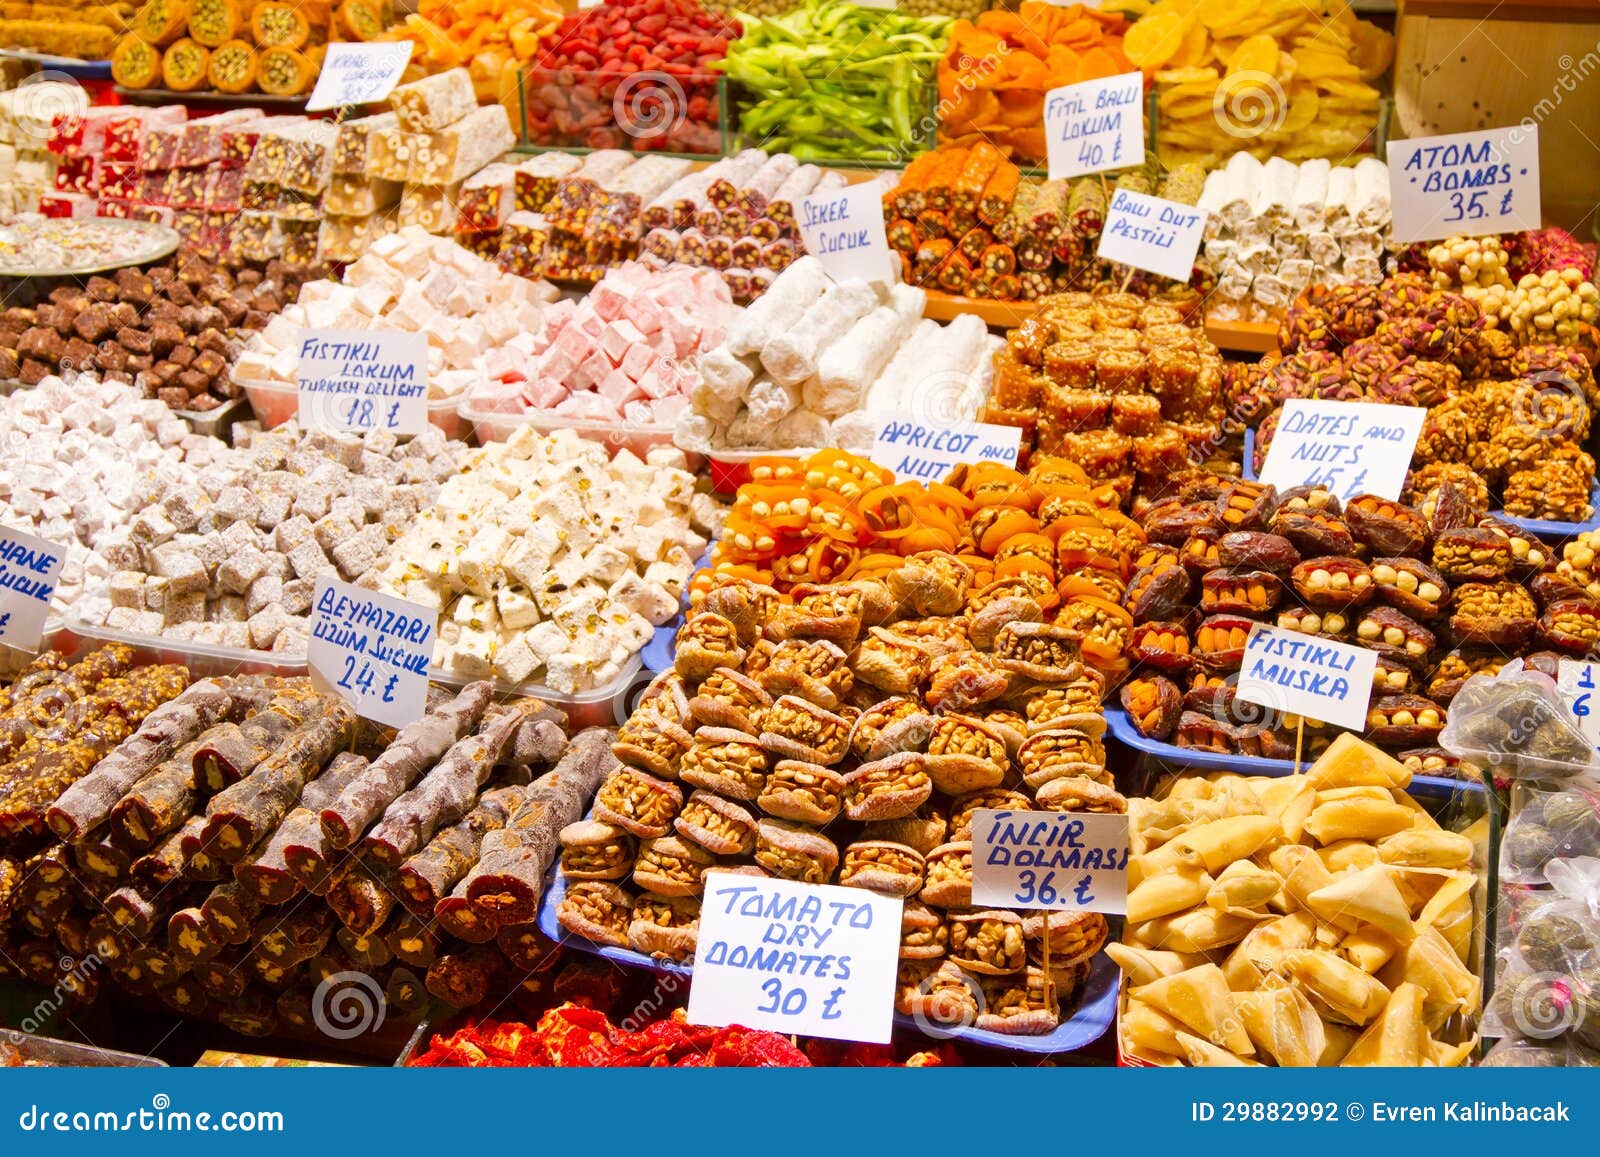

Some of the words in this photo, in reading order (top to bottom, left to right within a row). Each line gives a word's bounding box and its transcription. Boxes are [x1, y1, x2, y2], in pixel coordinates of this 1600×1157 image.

[1096, 86, 1138, 109] BALLI
[1062, 111, 1121, 141] LOKUM
[1404, 140, 1491, 171] ATOM
[1112, 192, 1151, 217] BALLI
[1160, 207, 1200, 228] DUT
[819, 229, 871, 254] SUCUK
[300, 338, 380, 360] FISTIKLI
[340, 362, 415, 381] LOKUM
[298, 379, 359, 395] TURKISH
[365, 382, 425, 397] DELIGHT
[879, 421, 978, 454] APRICOT
[978, 445, 1016, 461] AND
[1282, 410, 1360, 436] DATES
[1363, 426, 1405, 442] AND
[896, 455, 957, 479] NUT
[1291, 441, 1363, 465] NUTS
[317, 587, 431, 644] BEYPAZARI
[313, 614, 368, 654] ÜZÜM
[368, 634, 430, 677] SUCUK
[1248, 628, 1356, 672] FISTIKLI
[1249, 658, 1349, 701] MUSKA
[987, 845, 1129, 871] DOLMASI
[716, 886, 873, 929] TOMATO
[762, 923, 833, 949] DRY
[704, 941, 851, 980] DOMATES
[757, 977, 807, 1015] 30
